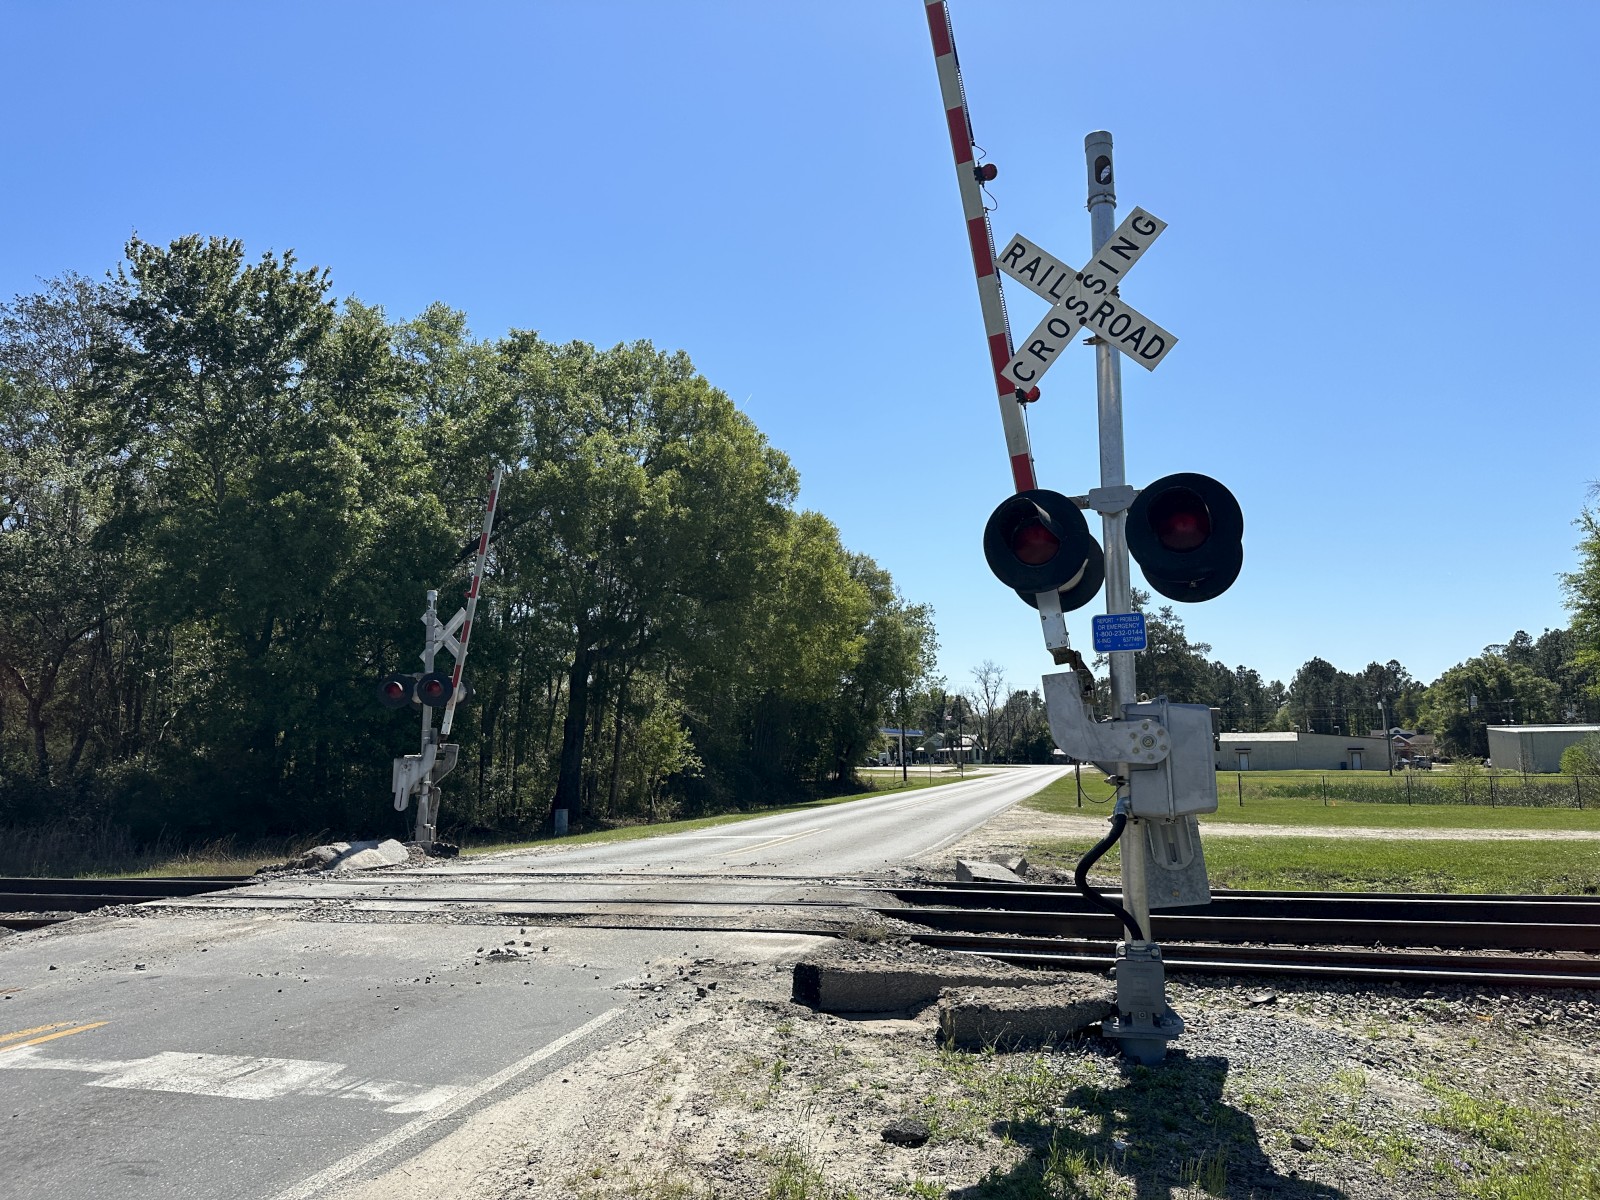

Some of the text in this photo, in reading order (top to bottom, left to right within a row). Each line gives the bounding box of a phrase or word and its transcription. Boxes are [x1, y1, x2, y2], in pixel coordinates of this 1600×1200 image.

[1002, 241, 1166, 360] RAIL ROAD
[1012, 215, 1157, 382] CROSSING
